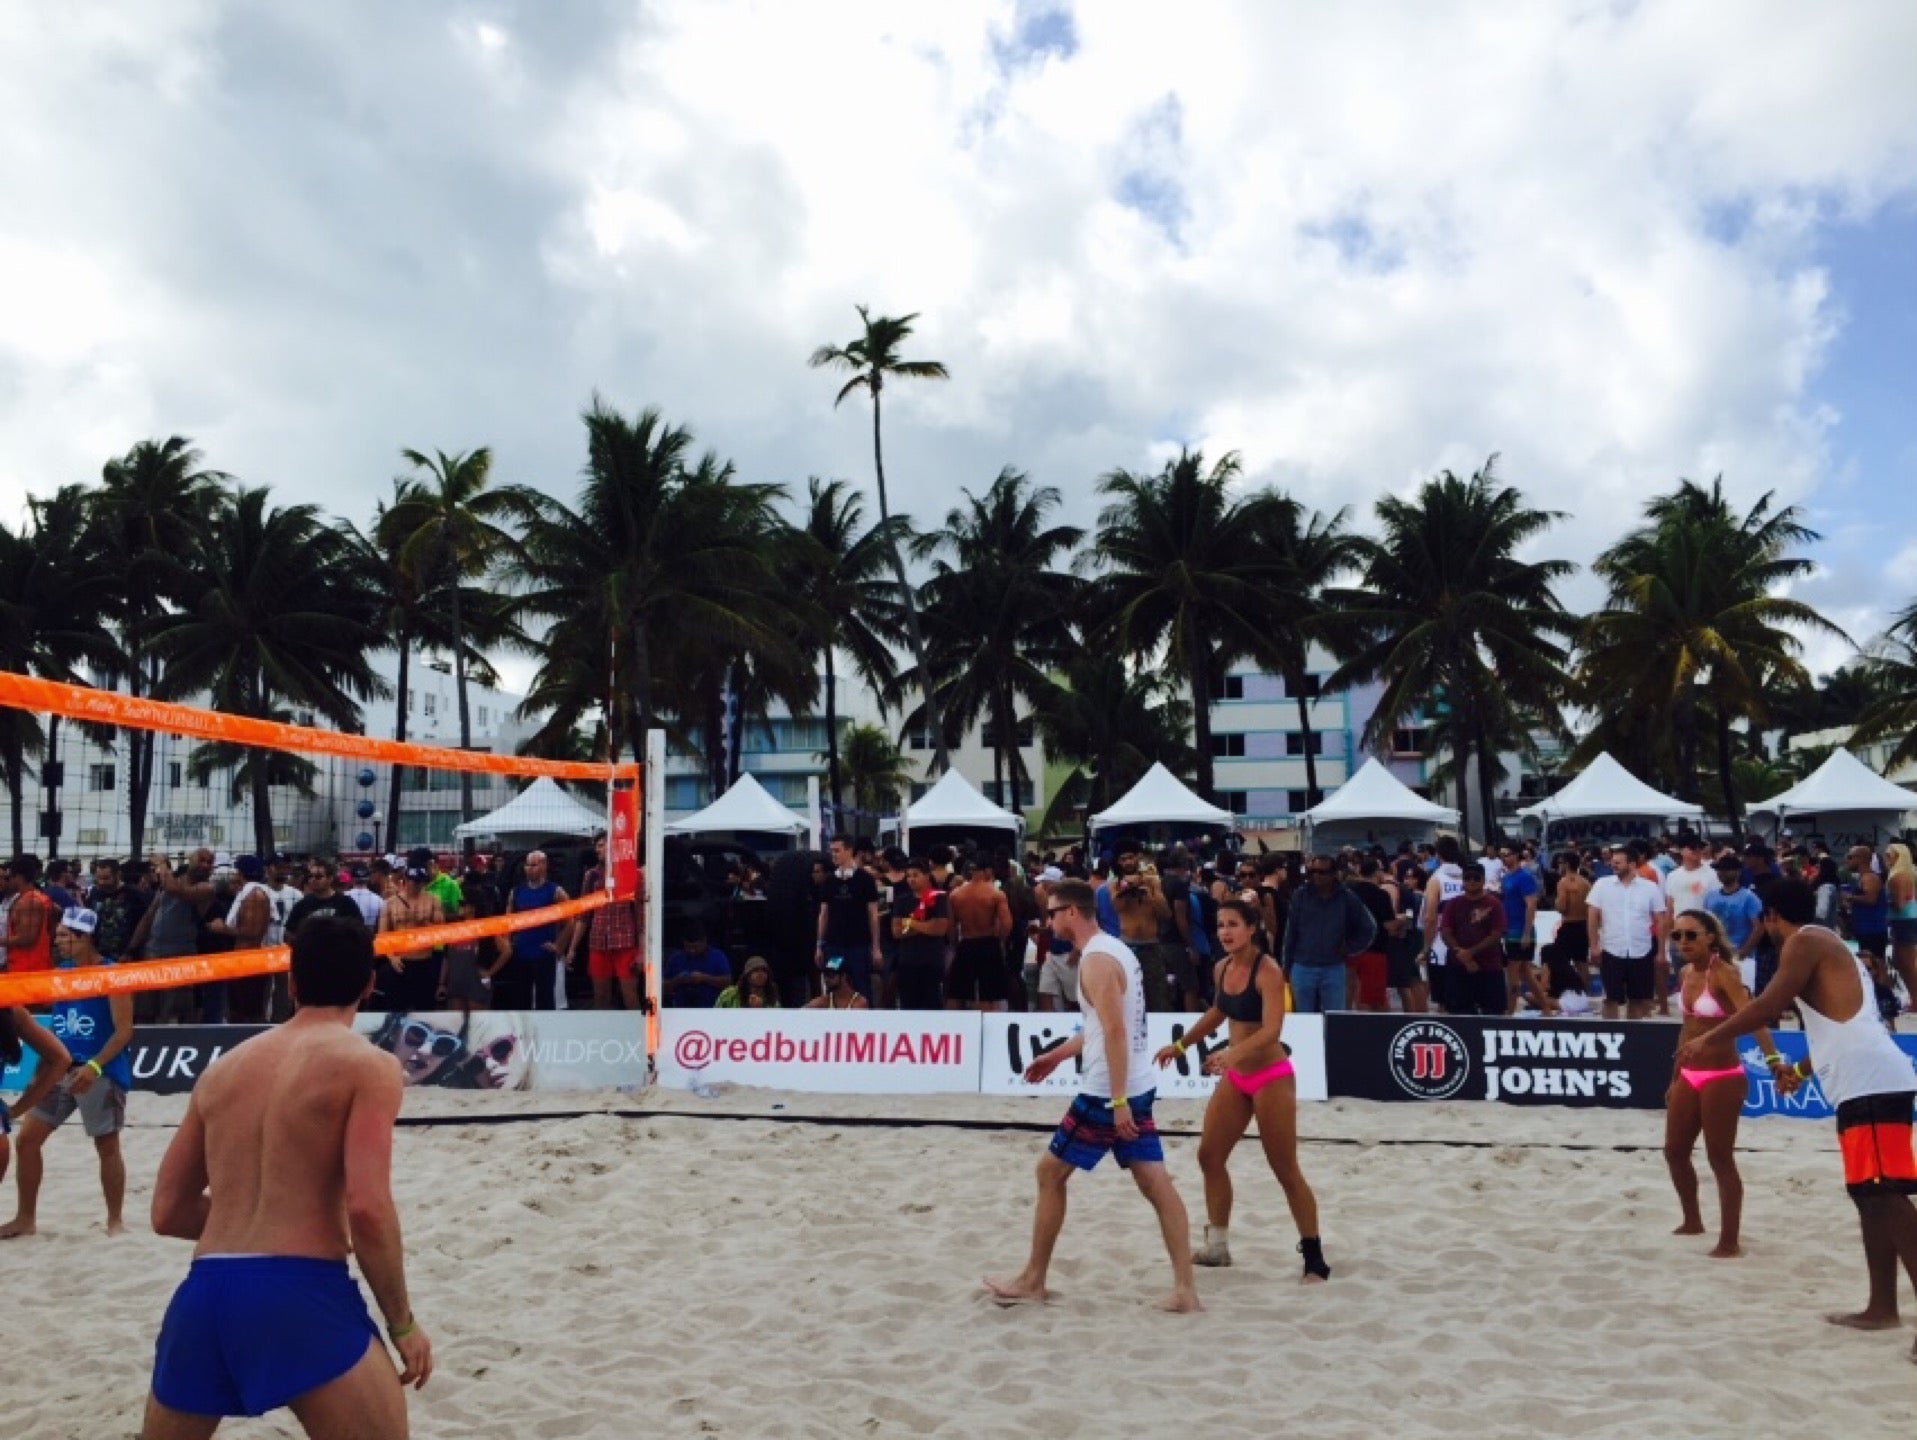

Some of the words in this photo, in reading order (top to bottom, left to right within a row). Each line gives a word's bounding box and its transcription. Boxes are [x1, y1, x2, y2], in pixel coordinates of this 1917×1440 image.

[519, 1039, 642, 1065] WILDFOX
[674, 1030, 962, 1070] @redbullMIAMI
[1411, 1043, 1447, 1079] JJ
[1482, 1029, 1625, 1063] JIMMY
[1484, 1065, 1632, 1101] JOHN'S
